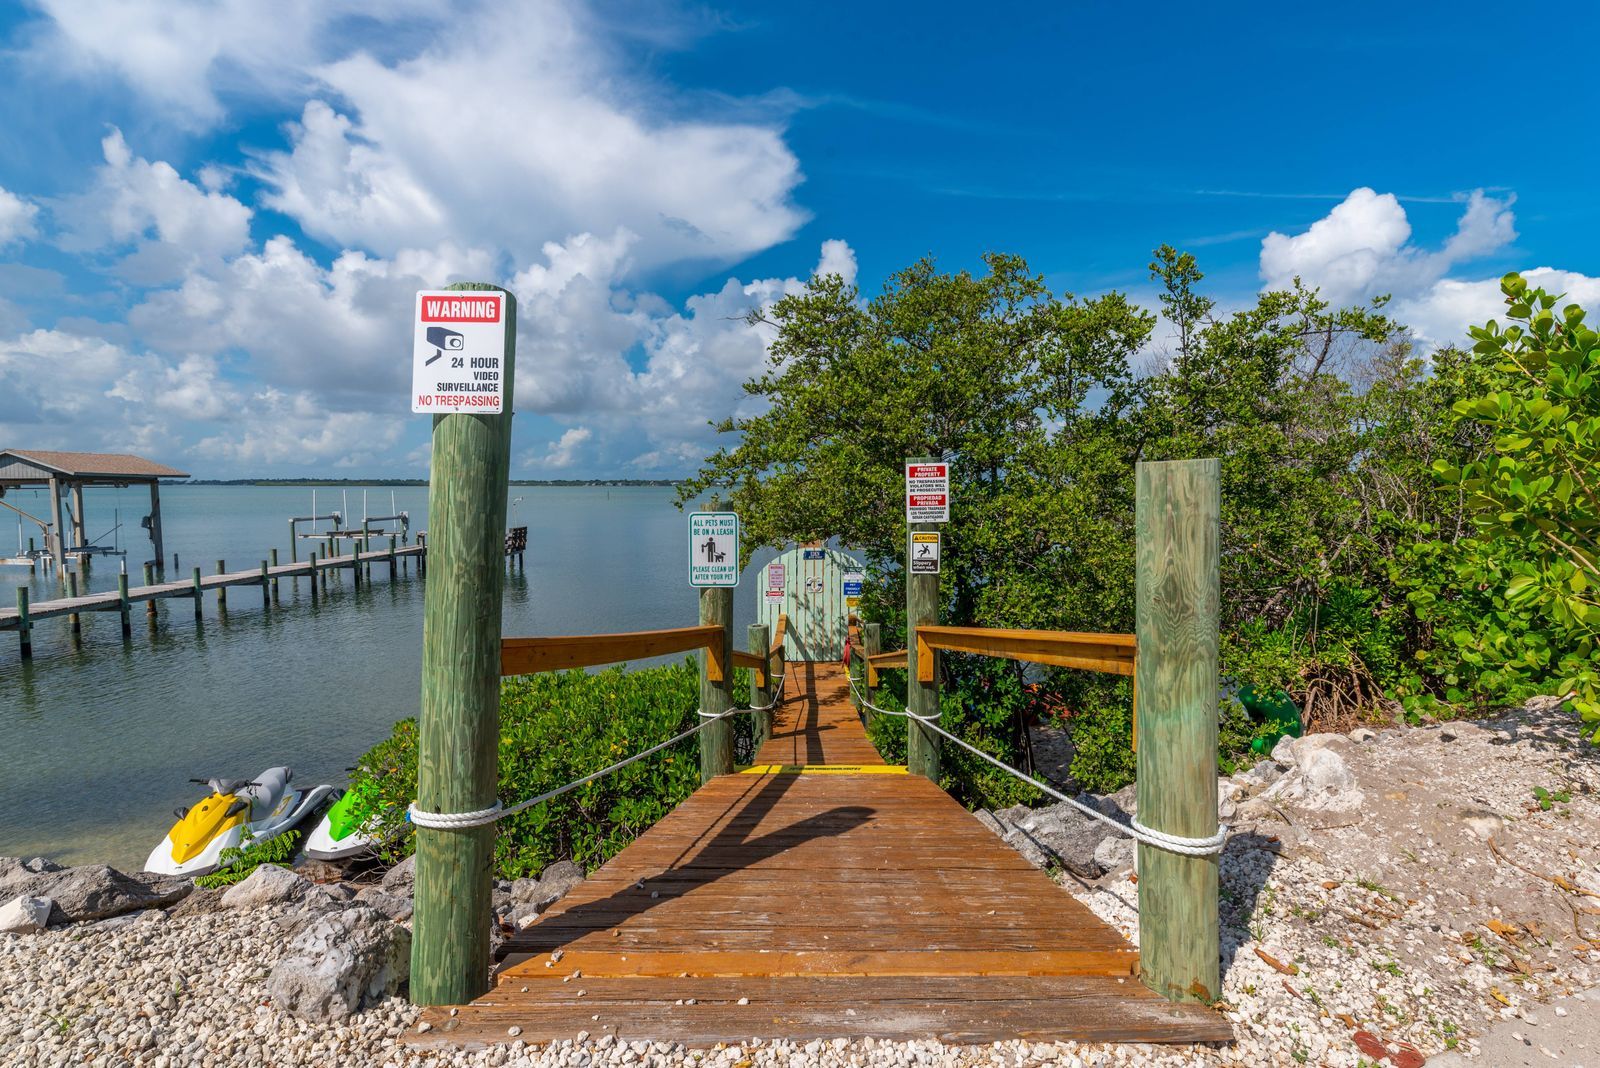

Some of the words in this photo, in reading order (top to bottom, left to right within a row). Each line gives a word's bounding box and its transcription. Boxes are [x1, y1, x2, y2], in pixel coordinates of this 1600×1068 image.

[427, 300, 496, 318] WARNING
[452, 357, 464, 368] 24
[470, 357, 499, 368] HOUR
[473, 371, 499, 380] VIDEO
[436, 382, 498, 392] SURVEILLANCE
[418, 395, 432, 406] NO
[435, 395, 500, 406] TRESPASSING
